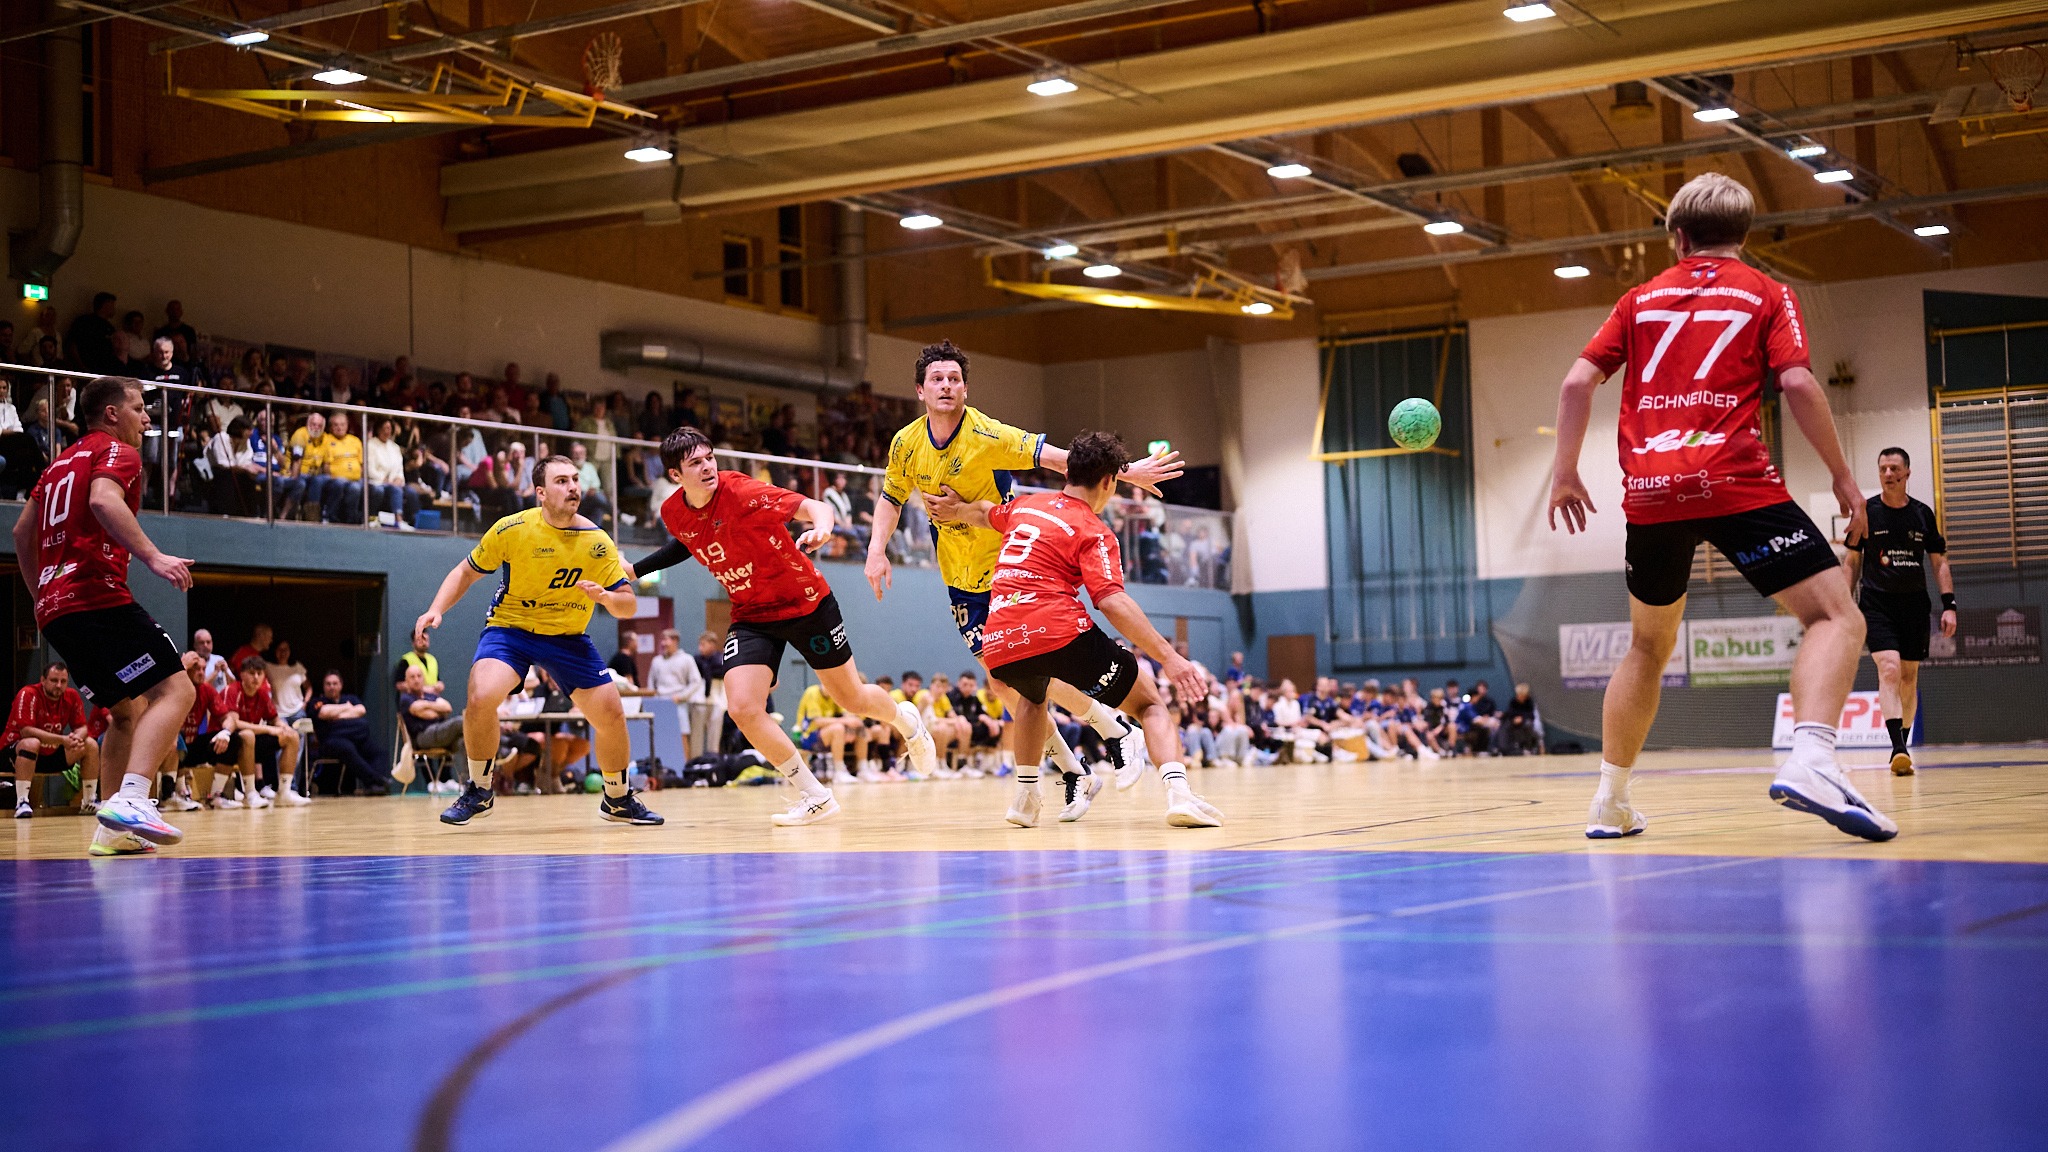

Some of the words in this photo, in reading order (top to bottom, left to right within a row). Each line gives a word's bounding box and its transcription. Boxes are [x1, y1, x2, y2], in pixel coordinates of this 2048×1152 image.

[1635, 309, 1753, 383] 77
[1627, 475, 1671, 491] Krause
[42, 470, 75, 531] 10
[696, 541, 726, 566] 19
[998, 523, 1040, 564] 8
[548, 567, 583, 590] 20
[1694, 634, 1775, 658] Rabus
